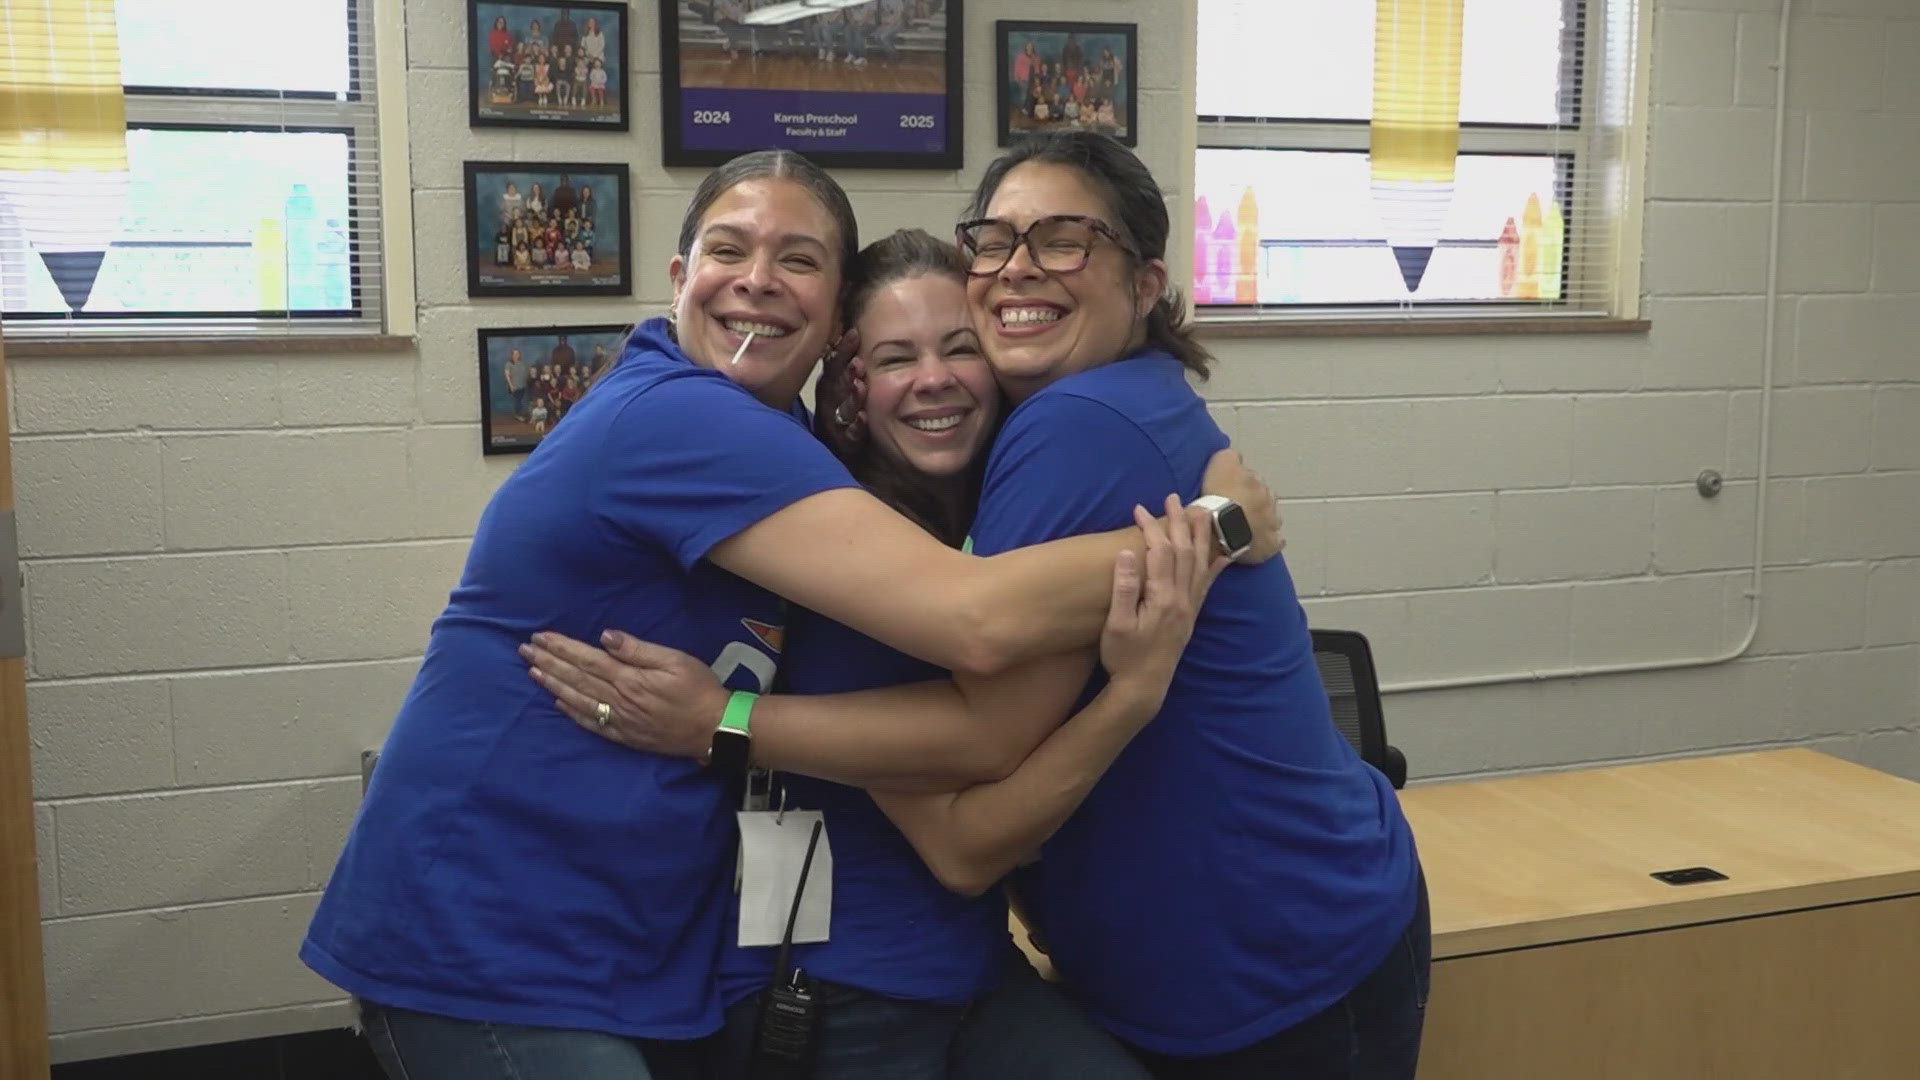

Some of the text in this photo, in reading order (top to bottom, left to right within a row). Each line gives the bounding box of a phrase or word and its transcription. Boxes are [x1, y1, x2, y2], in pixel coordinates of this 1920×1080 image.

[693, 110, 731, 124] 2024
[774, 113, 858, 125] Karns Preschool
[900, 115, 935, 129] 2025
[786, 126, 847, 138] Faculty & Staff
